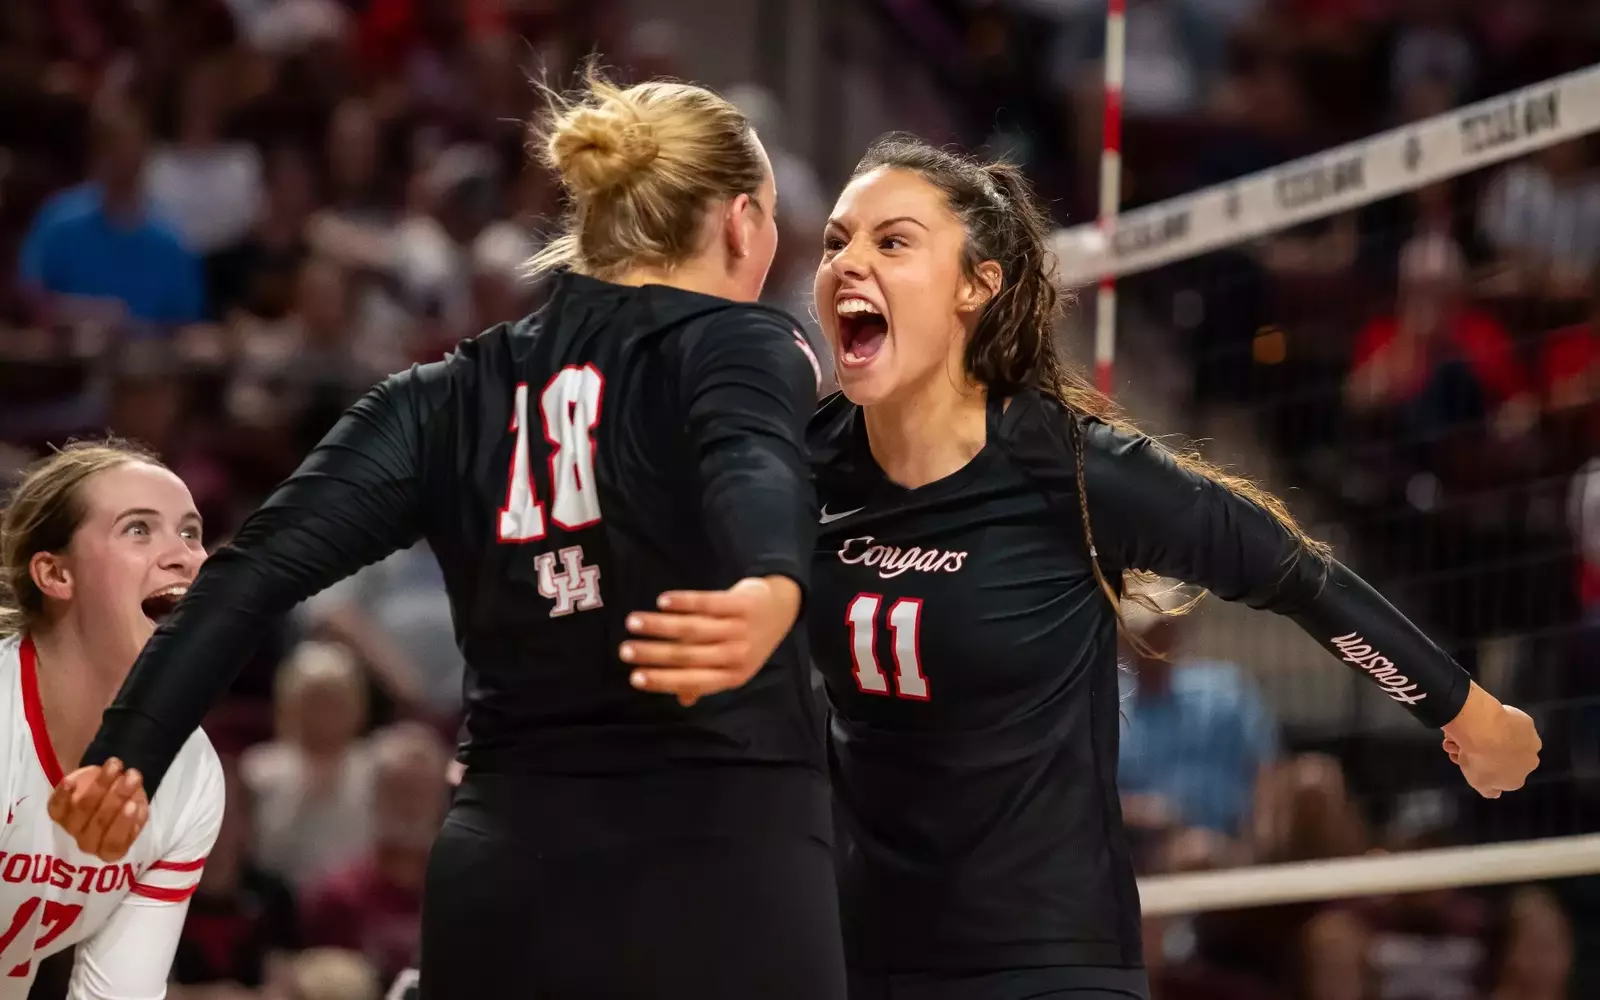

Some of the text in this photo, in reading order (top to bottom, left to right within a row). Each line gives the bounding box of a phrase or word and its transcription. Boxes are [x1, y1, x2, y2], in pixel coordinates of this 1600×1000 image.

[497, 361, 605, 543] 18
[838, 536, 968, 579] Cougars
[845, 592, 931, 702] 11
[1330, 631, 1428, 705] Houston
[0, 851, 141, 894] OUSTON
